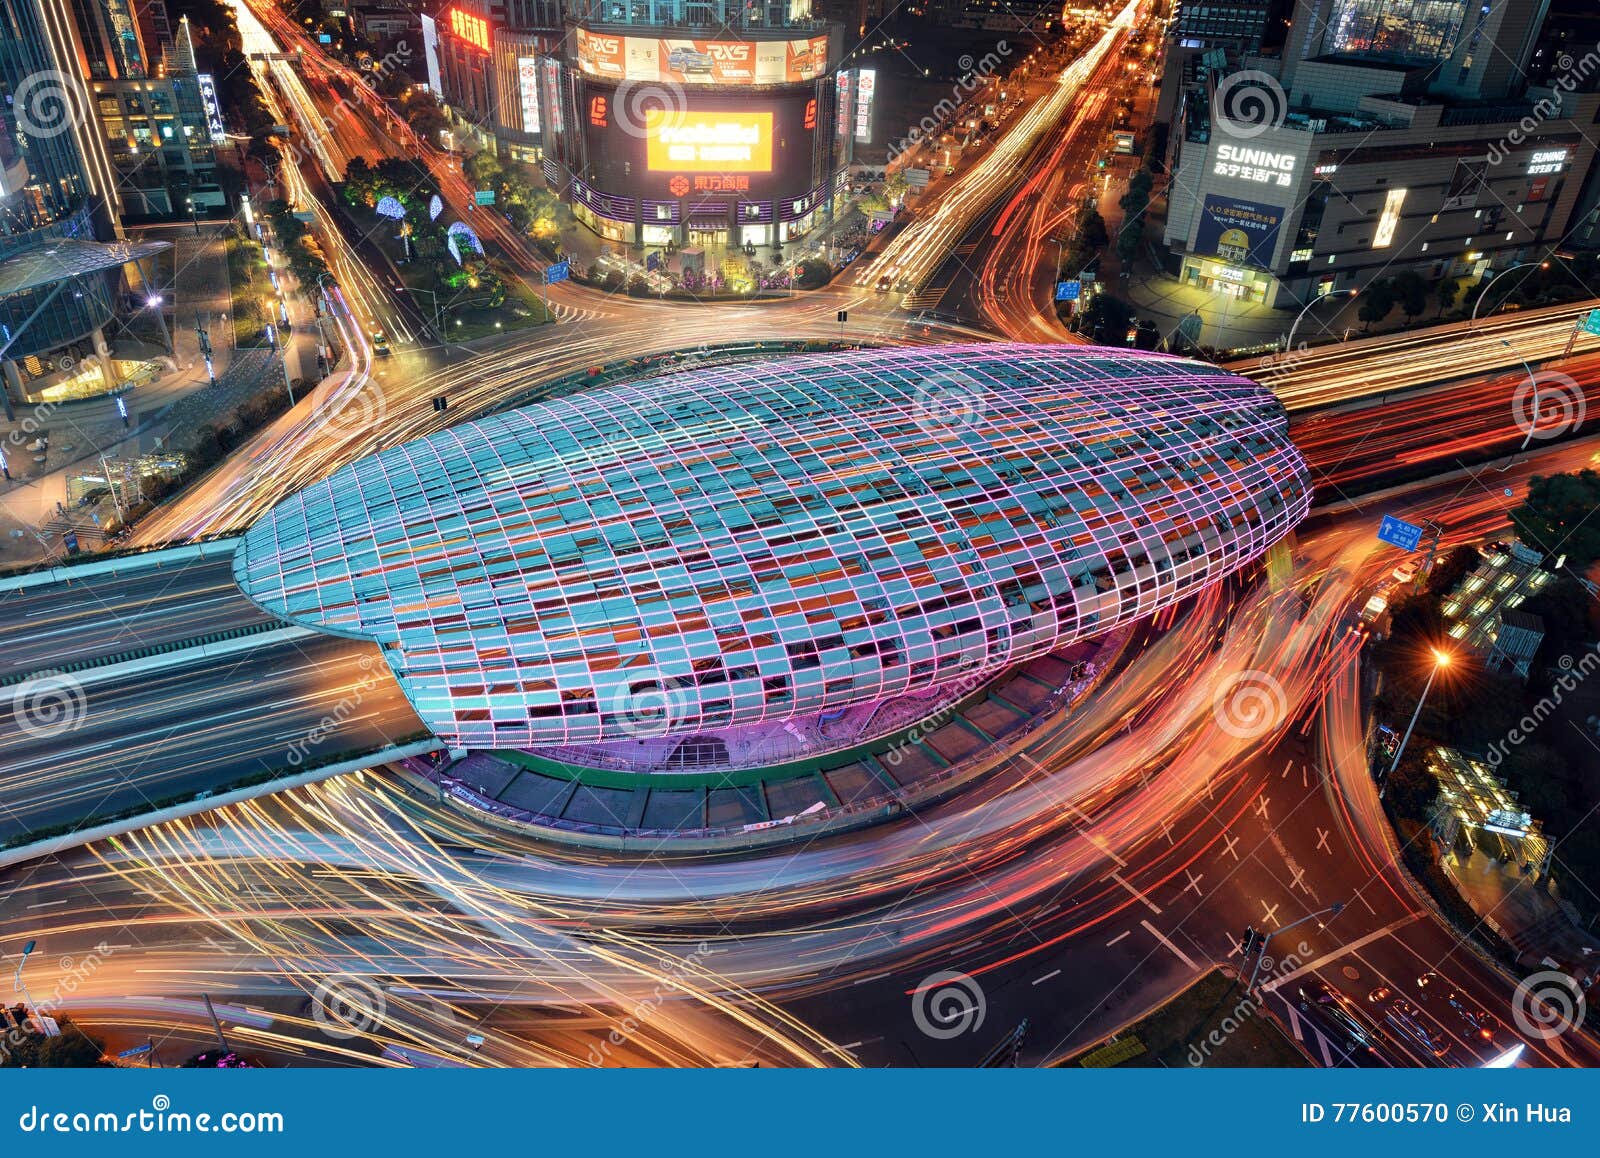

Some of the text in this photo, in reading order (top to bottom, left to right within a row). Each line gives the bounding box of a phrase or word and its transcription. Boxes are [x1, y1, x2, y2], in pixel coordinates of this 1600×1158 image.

[1216, 144, 1296, 171] SUNING
[1531, 150, 1567, 163] SUNING
[1213, 162, 1292, 187] 苏宁生活广场
